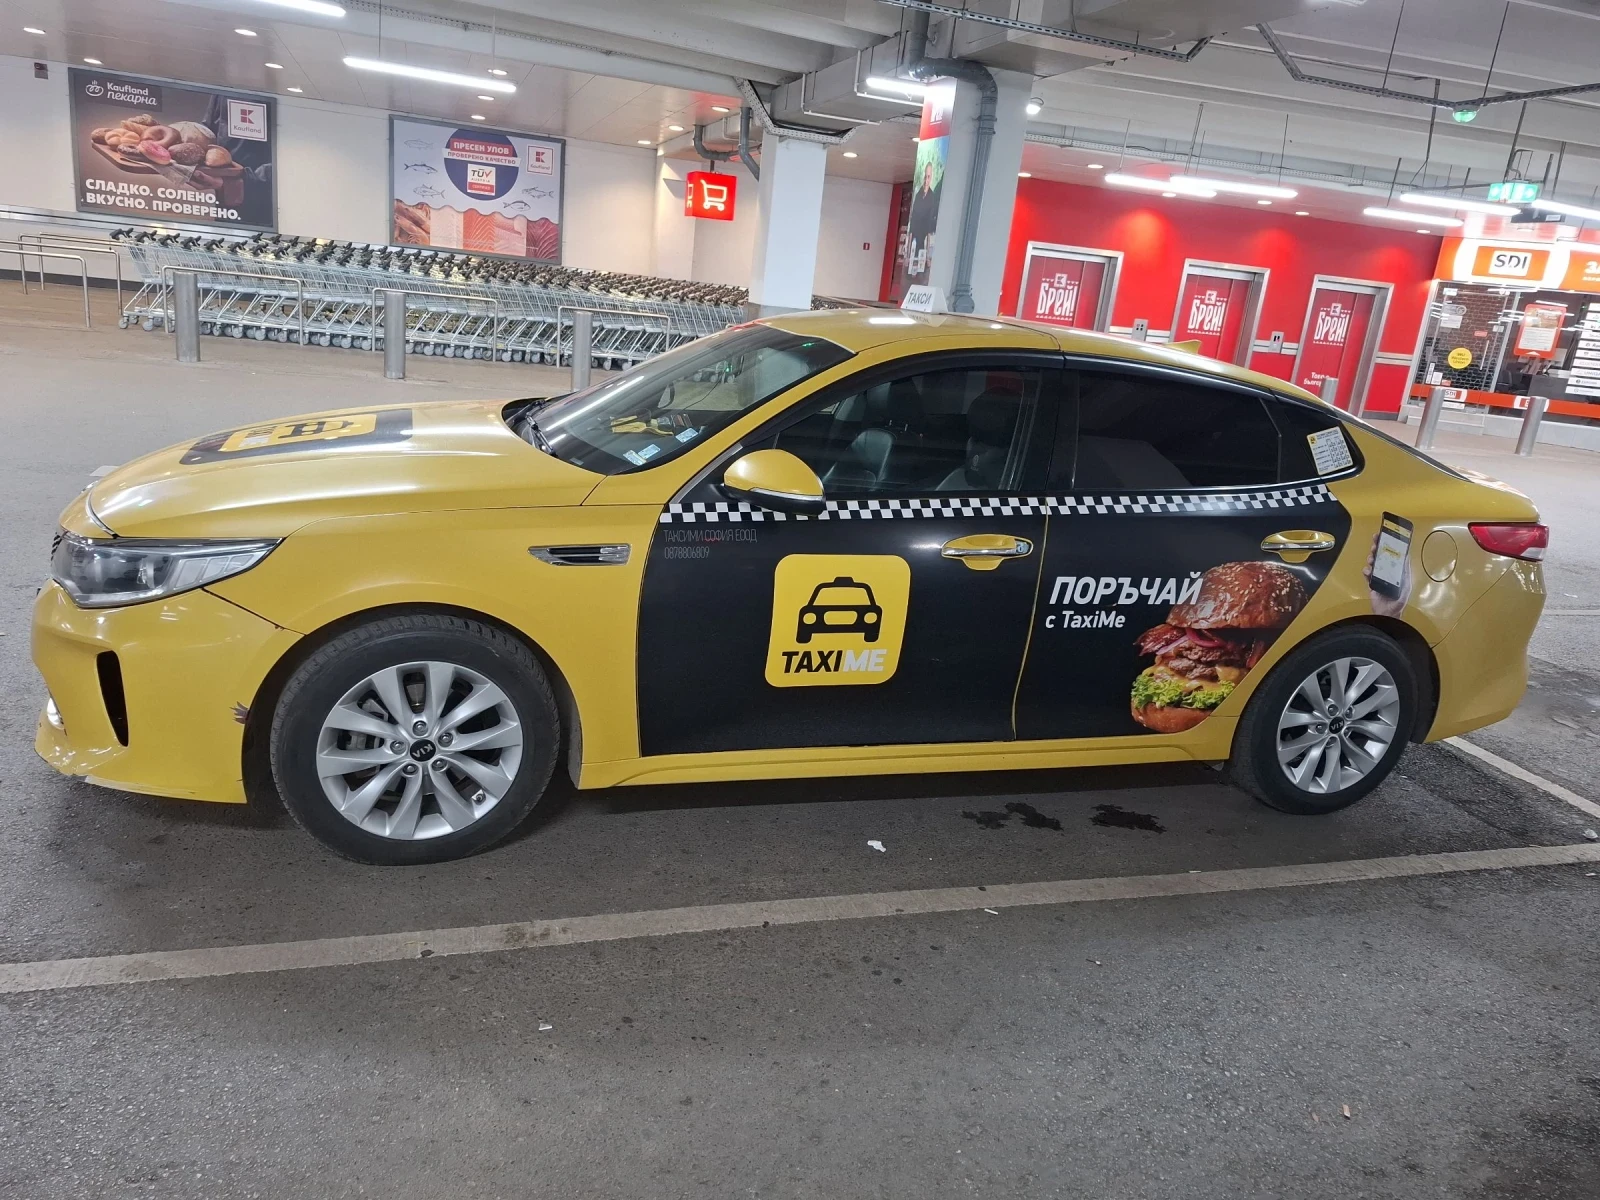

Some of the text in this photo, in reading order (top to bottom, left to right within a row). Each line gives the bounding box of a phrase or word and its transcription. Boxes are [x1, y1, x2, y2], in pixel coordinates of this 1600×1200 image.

[107, 82, 149, 95] Kaufland
[107, 91, 157, 105] пекарна
[233, 125, 262, 134] Kaufland
[453, 141, 510, 155] ПРЕСЕН УЛОВ
[447, 151, 516, 165] ПРОВЕРЕНО КАЧЕСТВО
[85, 178, 220, 205] СЛАДКО. СОЛЕНО.
[86, 192, 241, 220] ВКУСНО. ПРОВЕРЕНО.
[1494, 254, 1528, 270] SDI
[907, 292, 932, 305] ТАКСИ
[1036, 282, 1078, 317] Брей!
[1187, 299, 1226, 332] Брей!
[1313, 311, 1350, 342] Брей!
[663, 528, 758, 543] ТАКСИМИ СОФИЯ ЕООД
[1049, 571, 1204, 605] ПОРЪЧАЙ
[1045, 610, 1126, 629] с TaxiMe
[1331, 720, 1343, 731] KIA
[412, 743, 434, 758] KIA
